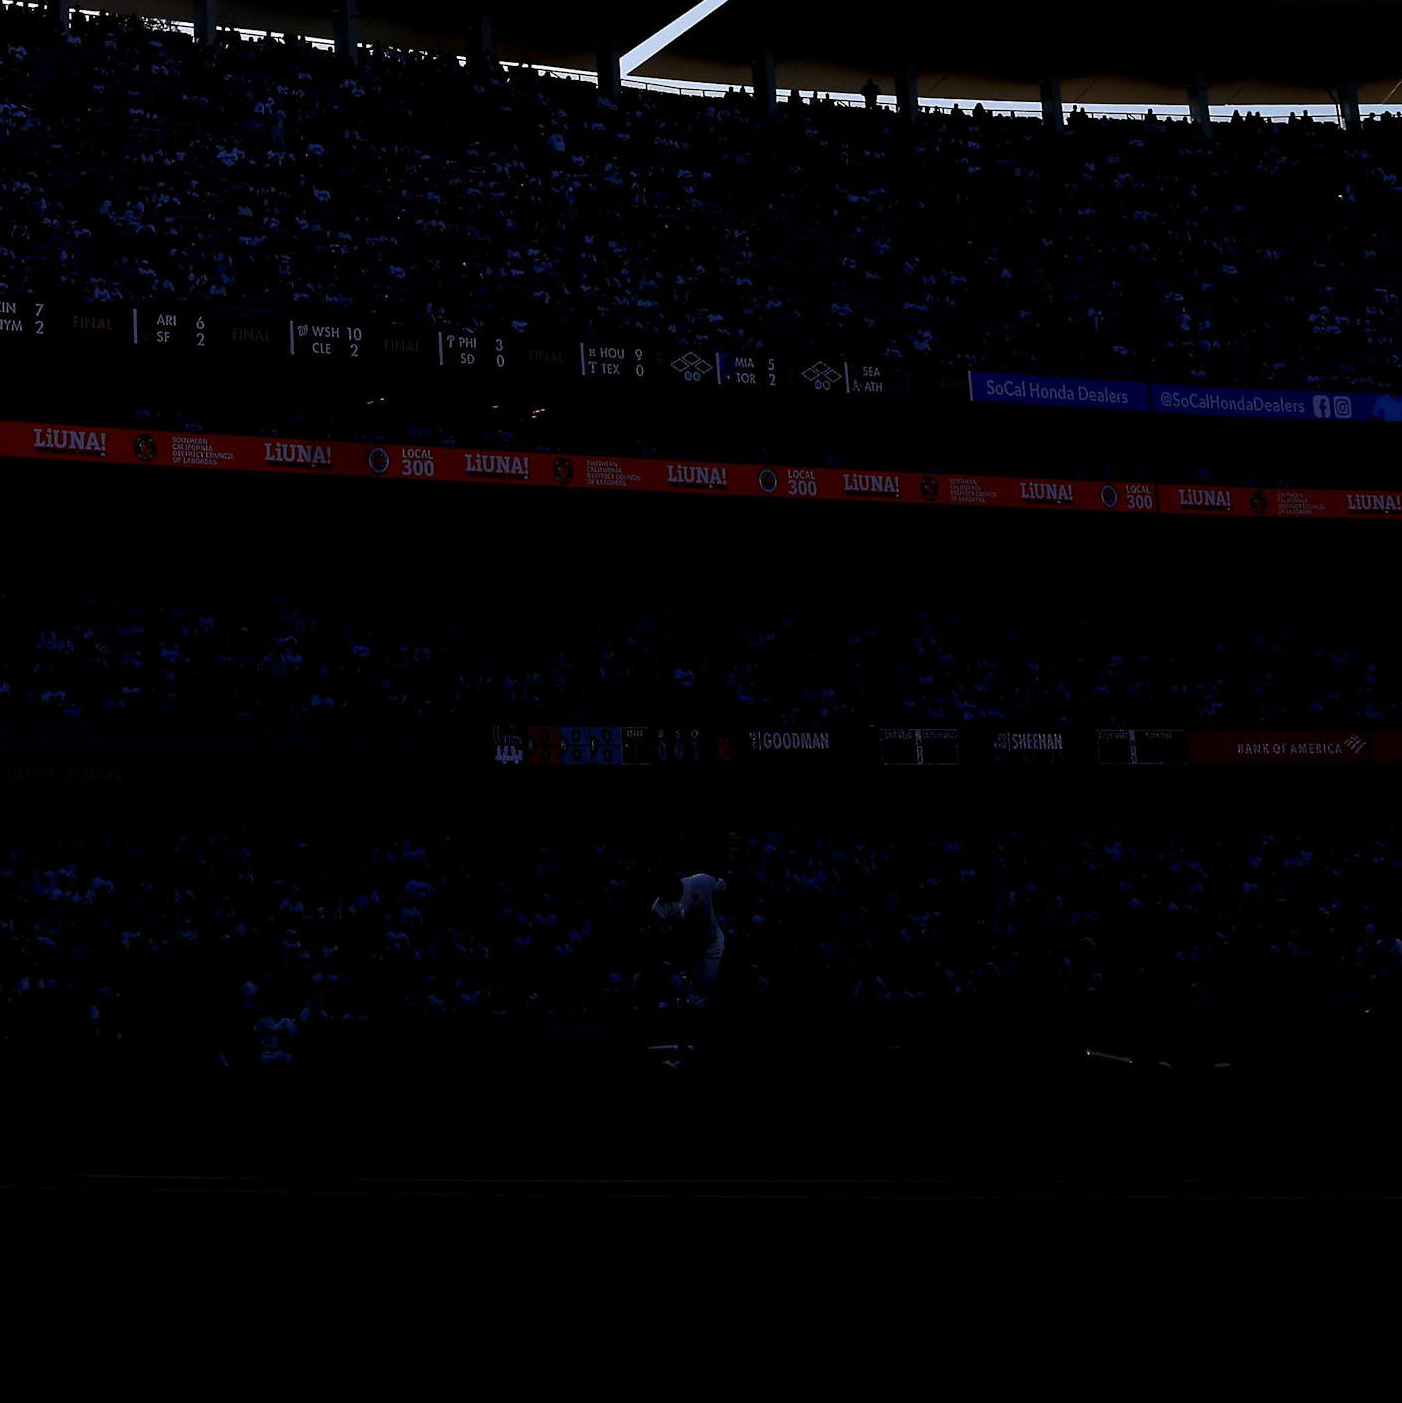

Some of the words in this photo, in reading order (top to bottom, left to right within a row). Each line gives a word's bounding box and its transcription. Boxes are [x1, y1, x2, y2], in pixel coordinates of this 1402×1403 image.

[34, 302, 44, 317] 7
[34, 320, 46, 334] 2
[73, 316, 113, 333] FINAL
[156, 313, 178, 327] ARI
[196, 316, 205, 330] 6
[156, 330, 171, 343] SF
[196, 333, 205, 347] 2
[231, 327, 270, 343] FINAL
[312, 325, 340, 339] WSH
[349, 327, 363, 342] 10
[312, 342, 332, 355] CLE
[350, 344, 359, 358] 2
[383, 338, 421, 353] FINAL
[458, 337, 477, 349] PHI
[495, 338, 504, 352] 3
[460, 352, 475, 365] SD
[497, 354, 505, 369] 0
[528, 350, 564, 365] FINAL
[600, 348, 625, 361] HOU
[635, 348, 643, 362] 9
[600, 362, 620, 375] TEX
[636, 363, 644, 378] 0
[734, 358, 755, 369] MIA
[768, 358, 776, 372] 5
[862, 366, 881, 378] SEA
[736, 372, 757, 385] TOR
[769, 373, 777, 387] 2
[864, 381, 883, 393] ATH
[986, 379, 1027, 398] SoCal
[1029, 383, 1076, 401] Honda
[1077, 386, 1130, 405] Dealers
[1160, 391, 1306, 415] @SoCalHondaDealers
[33, 427, 108, 457] LiUNA!
[263, 442, 332, 468] LiUNA!
[401, 449, 434, 461] LOCAL
[401, 460, 435, 477] 300
[464, 453, 530, 480] LiUNA!
[666, 464, 727, 489] LiUNA!
[788, 470, 816, 481] LOCAL
[787, 480, 818, 497] 300
[843, 473, 901, 497] LiUNA!
[1019, 481, 1074, 504] LiUNA!
[1125, 484, 1151, 495] LOCAL
[1125, 494, 1153, 510] 300
[1178, 489, 1232, 511] LiUNA!
[1346, 494, 1402, 514] LiUNA!
[762, 732, 830, 750] GOODMAN
[1012, 732, 1063, 750] SHEEHAN
[1237, 742, 1270, 755] BANK
[1272, 742, 1288, 755] OF
[1289, 743, 1343, 755] AMERICA
